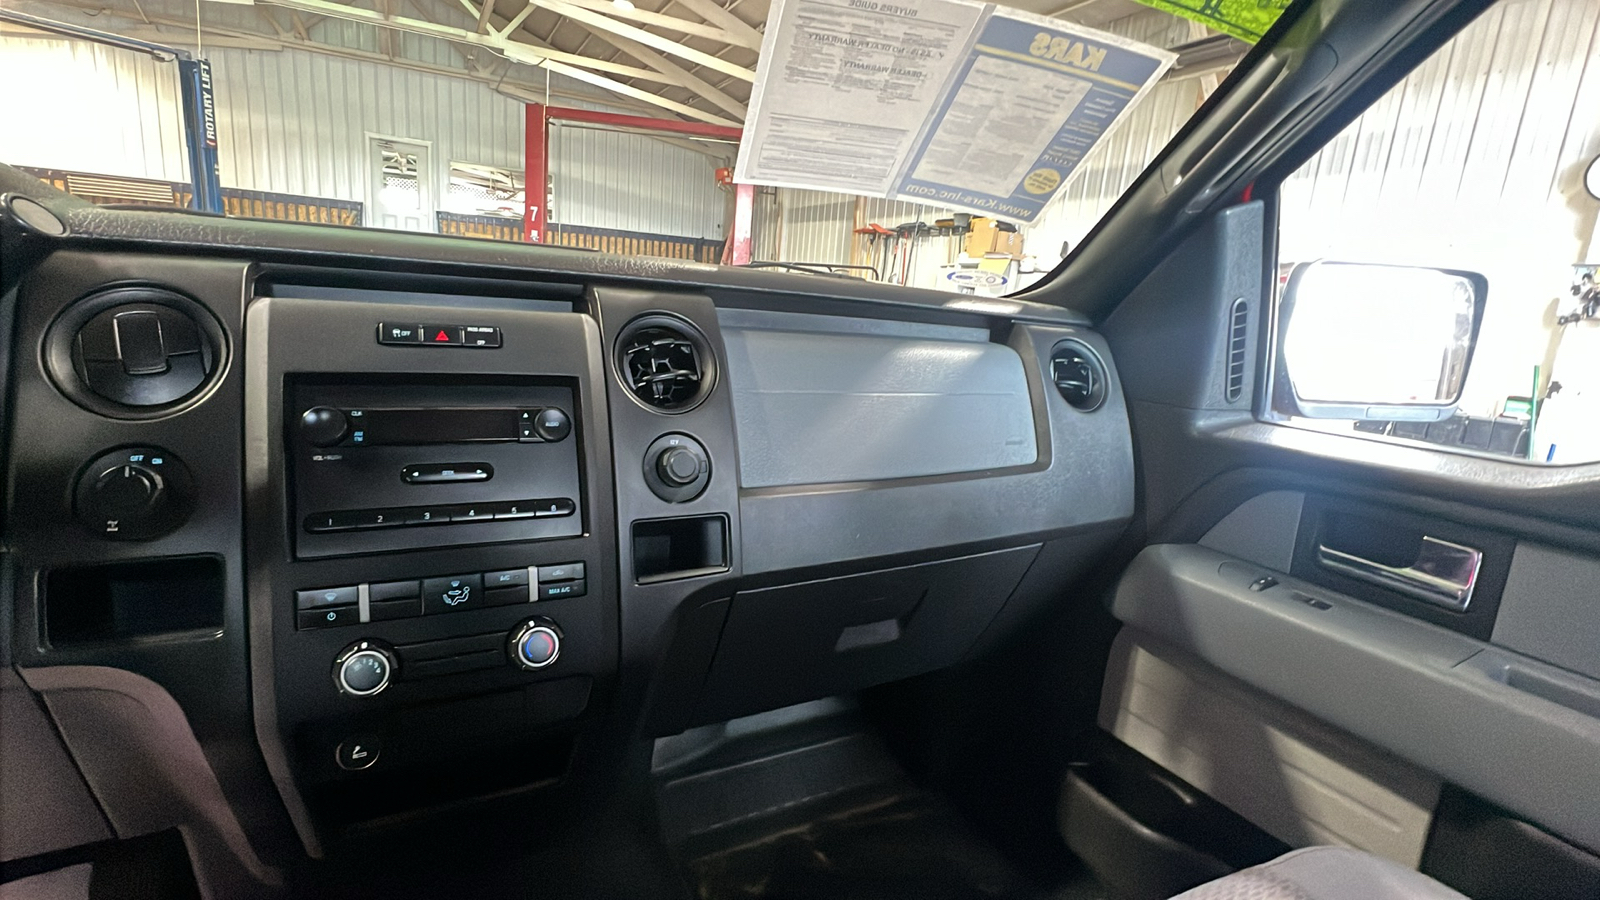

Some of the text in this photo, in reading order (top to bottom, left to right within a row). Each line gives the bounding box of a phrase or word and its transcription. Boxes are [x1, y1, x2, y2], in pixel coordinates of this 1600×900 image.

[201, 62, 215, 140] ROTARY LIFT
[530, 206, 538, 221] 7
